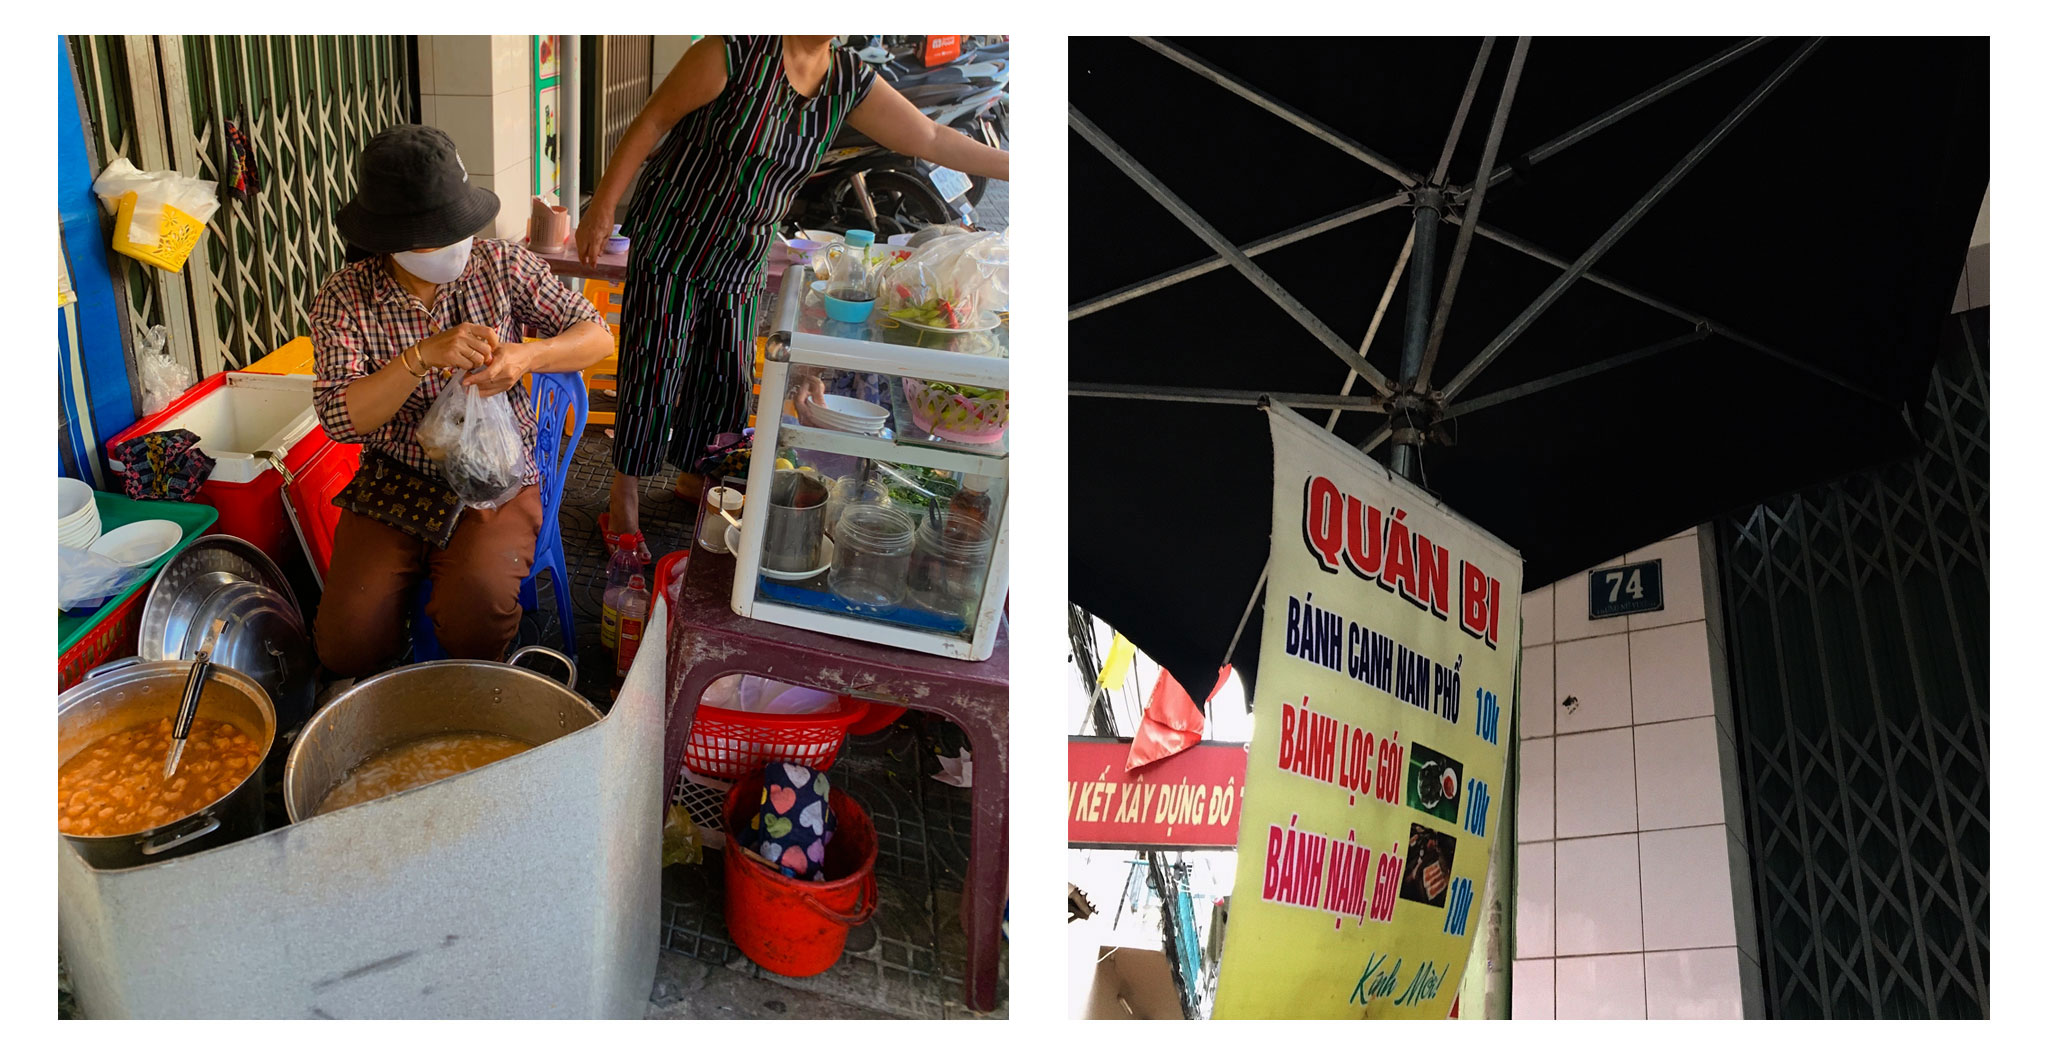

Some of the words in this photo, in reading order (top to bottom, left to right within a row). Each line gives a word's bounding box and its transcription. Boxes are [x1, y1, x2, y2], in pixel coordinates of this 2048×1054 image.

[1302, 475, 1449, 621] QUÁN
[1460, 560, 1500, 650] BI
[1605, 568, 1643, 602] 74
[1286, 592, 1343, 673] BÁNH
[1348, 621, 1394, 694] CANH
[1395, 644, 1431, 711] NAM
[1434, 653, 1462, 724] PHỔ
[1075, 765, 1117, 822] KẾT
[1114, 774, 1156, 823] XÂY
[1155, 776, 1206, 837] DỰNG
[1208, 777, 1234, 826] ĐÔ
[1278, 696, 1337, 783] BÁNH
[1340, 724, 1374, 806] LỌC
[1375, 731, 1403, 805] GÓI
[1263, 814, 1326, 908] BÁNH
[1323, 829, 1370, 929] NẬM,
[1370, 842, 1403, 922] GÓI
[1349, 952, 1402, 1005] Kính
[1394, 961, 1450, 1007] Mời!
